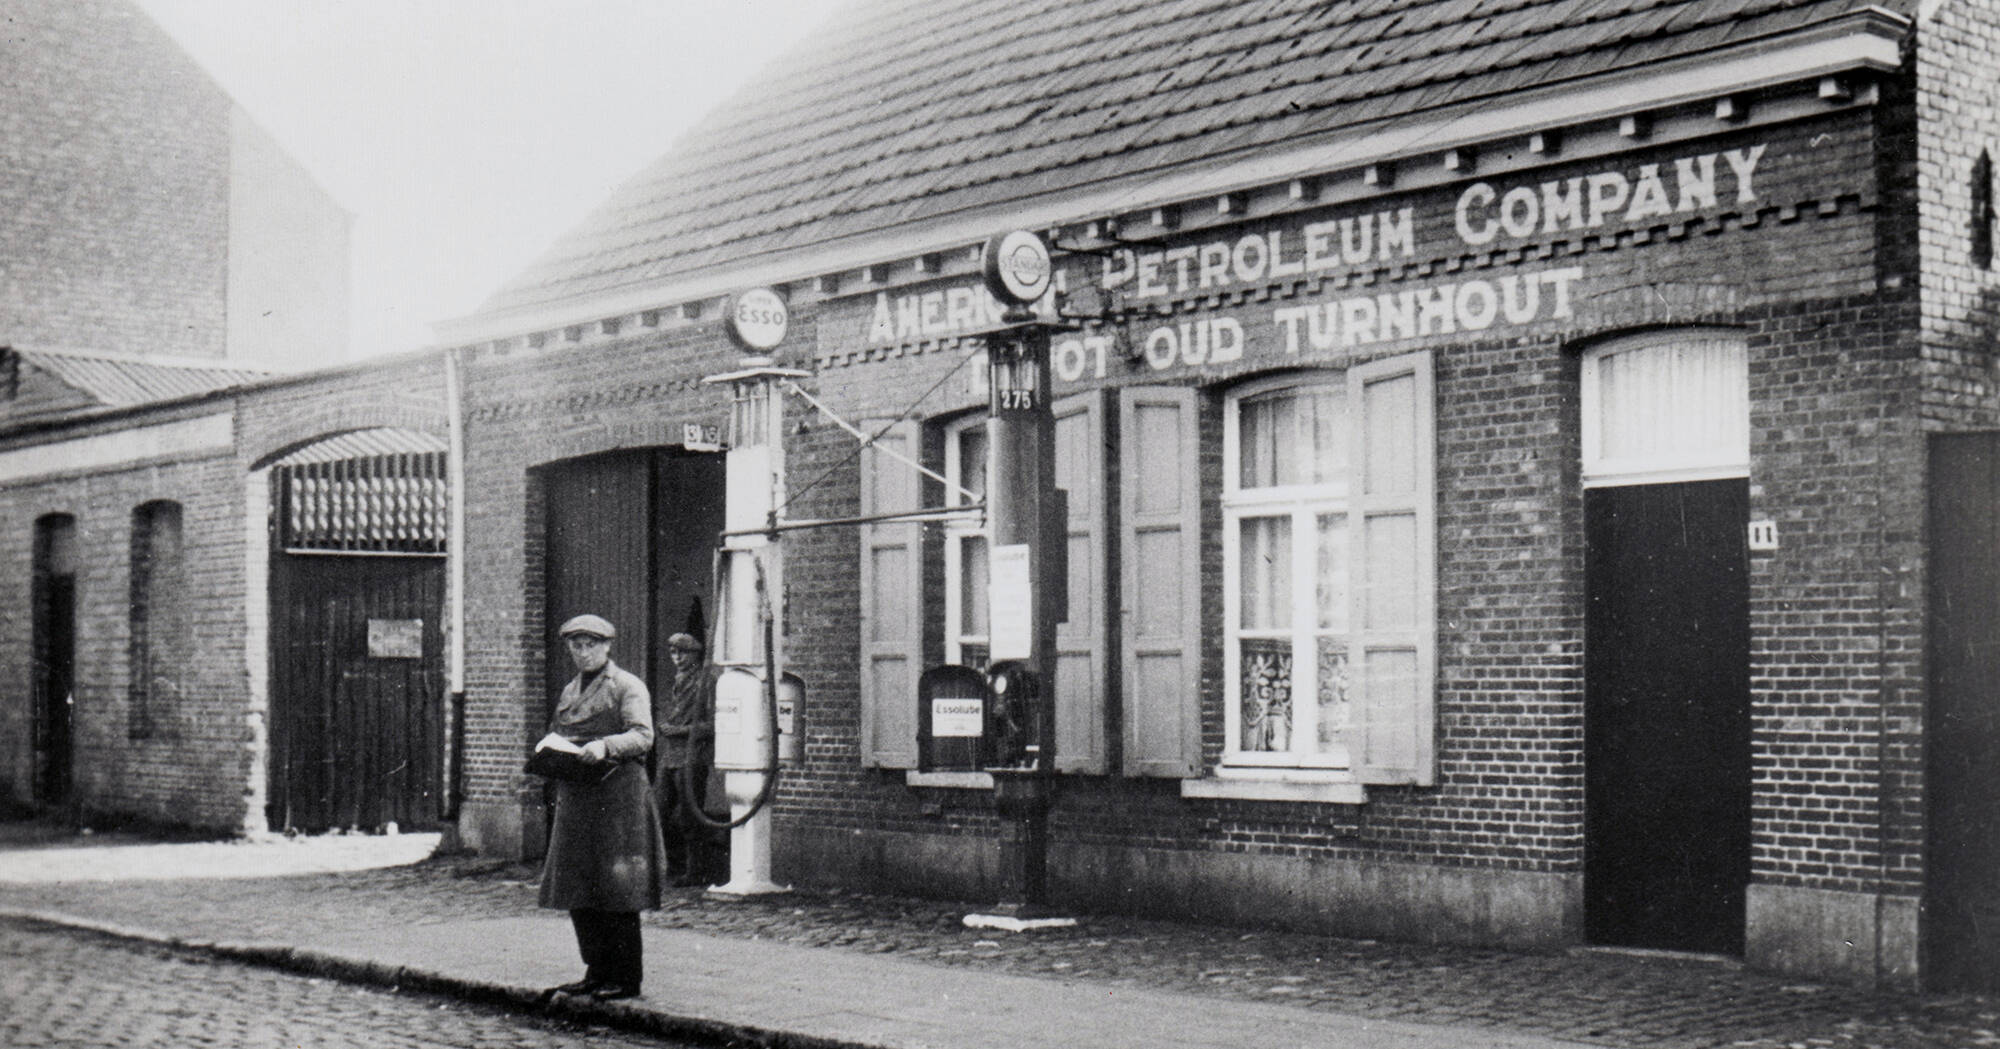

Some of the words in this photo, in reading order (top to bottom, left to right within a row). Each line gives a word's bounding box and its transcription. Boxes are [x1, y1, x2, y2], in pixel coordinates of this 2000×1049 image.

[1102, 206, 1416, 298] PETROLEUM
[1455, 143, 1768, 246] COMPANY
[1146, 316, 1244, 370] OUD
[1274, 266, 1584, 354] TURNHOUT
[1001, 391, 1032, 409] 275
[1754, 526, 1772, 543] 11
